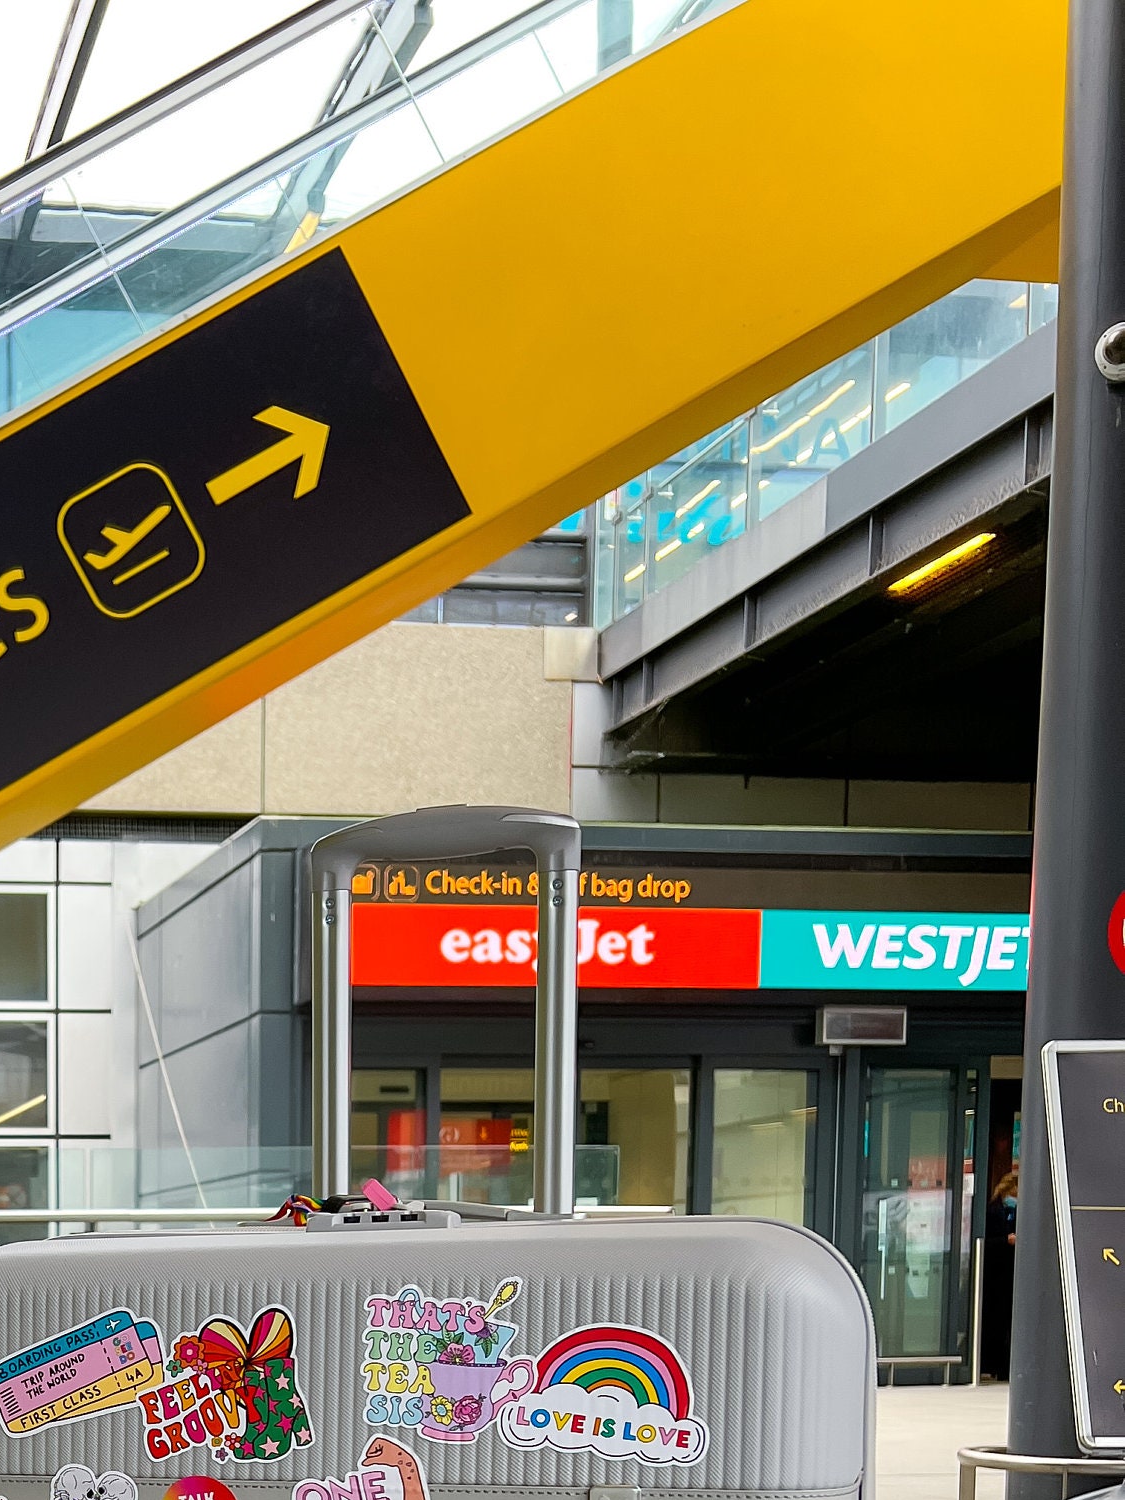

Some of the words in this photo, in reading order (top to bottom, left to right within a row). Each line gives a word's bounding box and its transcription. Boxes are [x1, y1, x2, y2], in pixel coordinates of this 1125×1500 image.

[424, 870, 522, 896] Check-in
[591, 872, 634, 903] bag
[638, 872, 692, 904] drop
[439, 918, 655, 971] easJet
[367, 1299, 487, 1333] THAT'S
[66, 1328, 94, 1348] PASS
[365, 1329, 438, 1364] THE
[21, 1371, 44, 1389] TRIP
[49, 1353, 85, 1377] AROUND
[26, 1385, 45, 1400] THE
[47, 1368, 77, 1389] WORLD
[364, 1363, 436, 1395] TEA
[20, 1404, 57, 1429] FIRST
[62, 1385, 102, 1410] CLASS
[125, 1369, 144, 1382] 4A
[366, 1394, 425, 1426] SIS
[146, 1385, 262, 1460] GROOVY
[516, 1406, 585, 1435] LOVE
[592, 1416, 616, 1438] IS
[622, 1421, 691, 1448] LOVE
